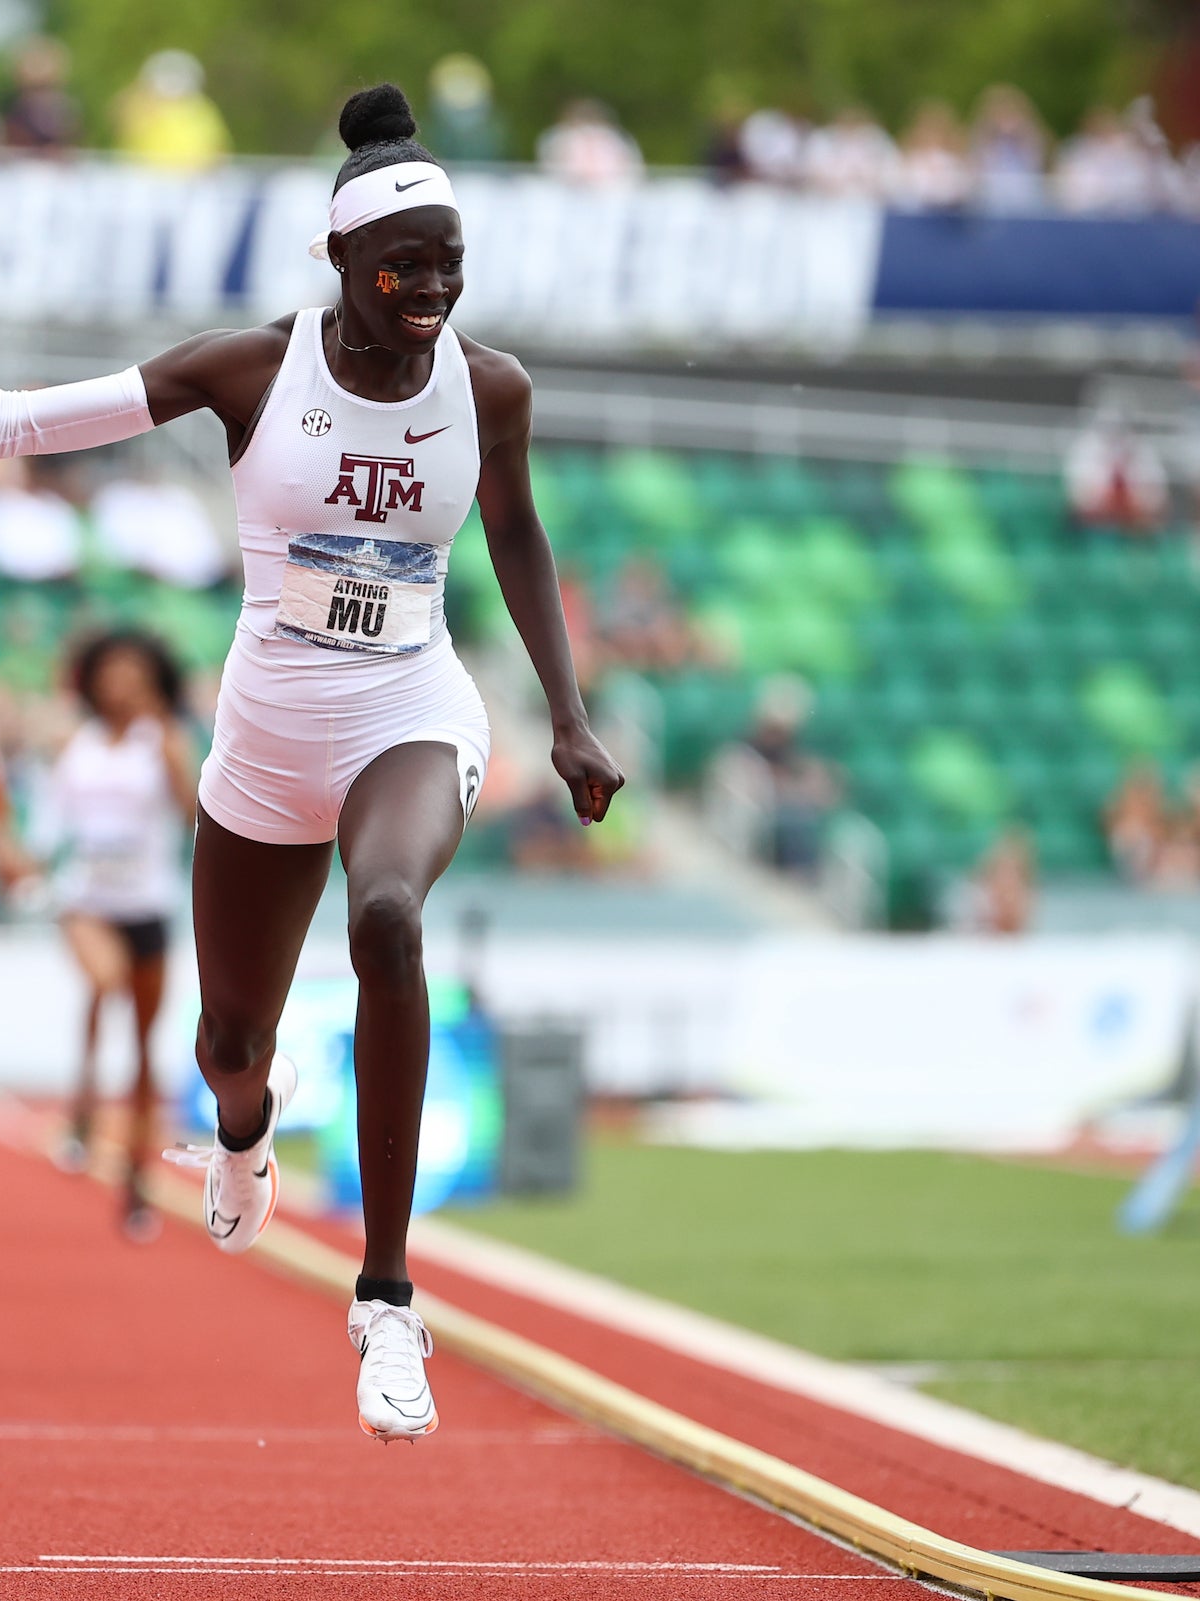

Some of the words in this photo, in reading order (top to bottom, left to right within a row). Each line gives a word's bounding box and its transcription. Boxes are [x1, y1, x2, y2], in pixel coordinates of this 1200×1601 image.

[303, 409, 332, 437] SEC
[333, 579, 390, 601] ATHING
[326, 596, 387, 637] MU
[304, 632, 337, 646] HAYWARD
[336, 639, 355, 650] FIELD
